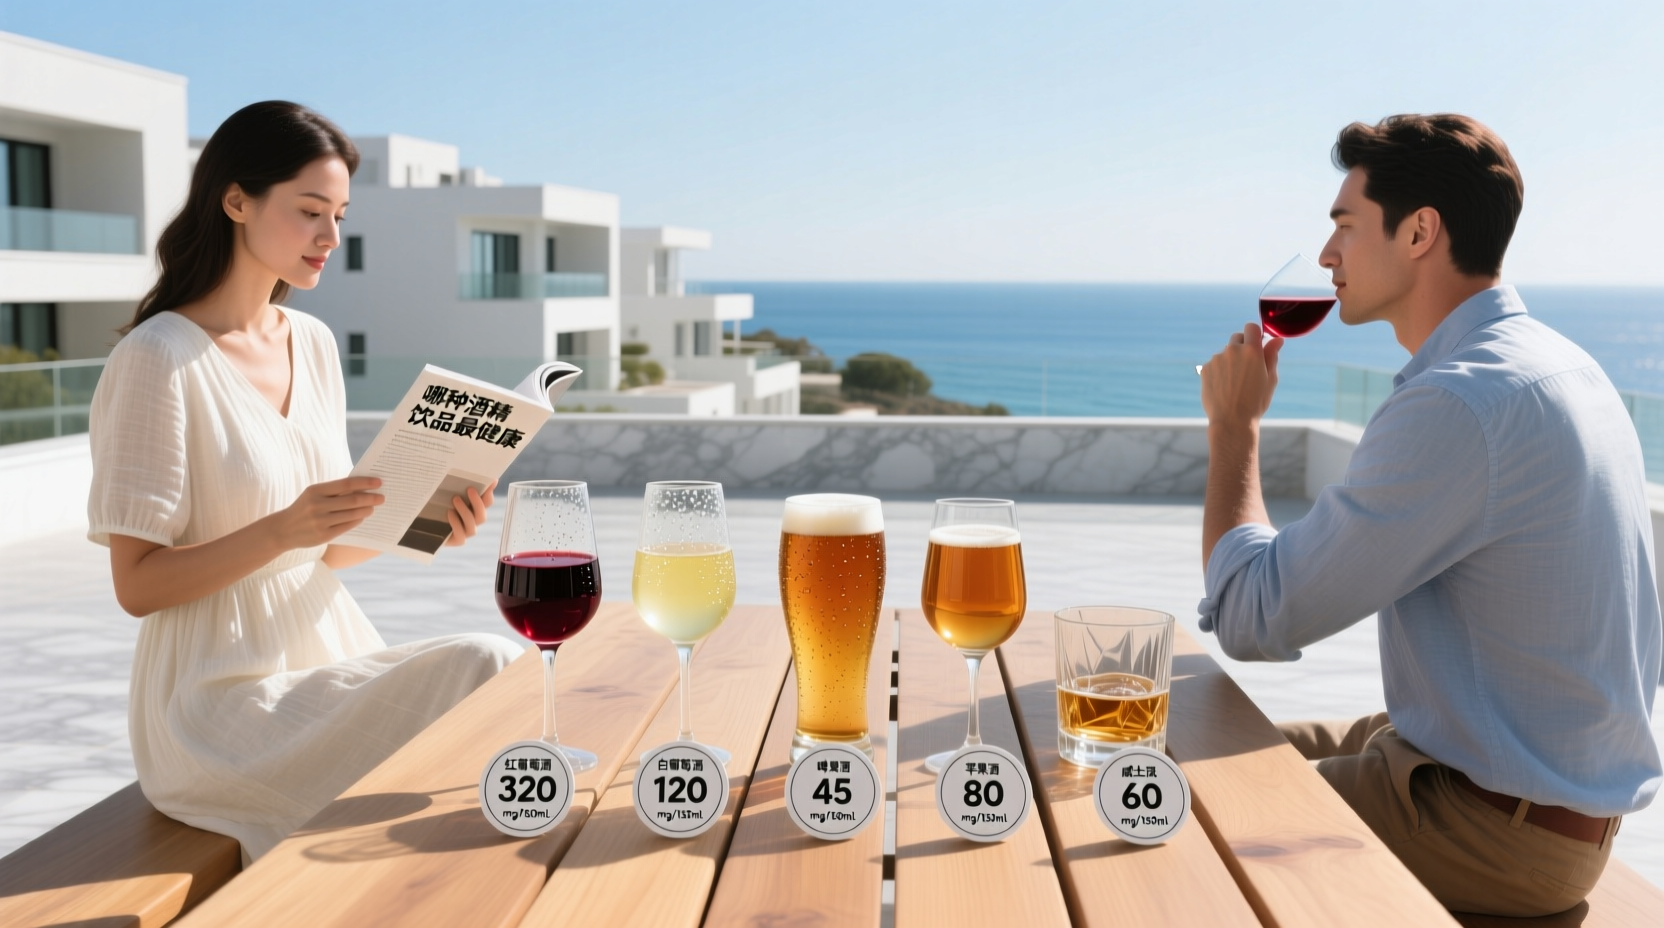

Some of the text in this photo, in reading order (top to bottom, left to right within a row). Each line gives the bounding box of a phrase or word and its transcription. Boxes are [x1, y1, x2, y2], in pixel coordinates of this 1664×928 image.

[421, 384, 514, 423] 哪种酒精
[407, 403, 526, 450] 饮品最健康
[498, 775, 557, 803] 320
[653, 776, 708, 804] 120
[812, 778, 852, 805] 45
[963, 779, 1004, 807] 80
[1121, 782, 1163, 810] 60
